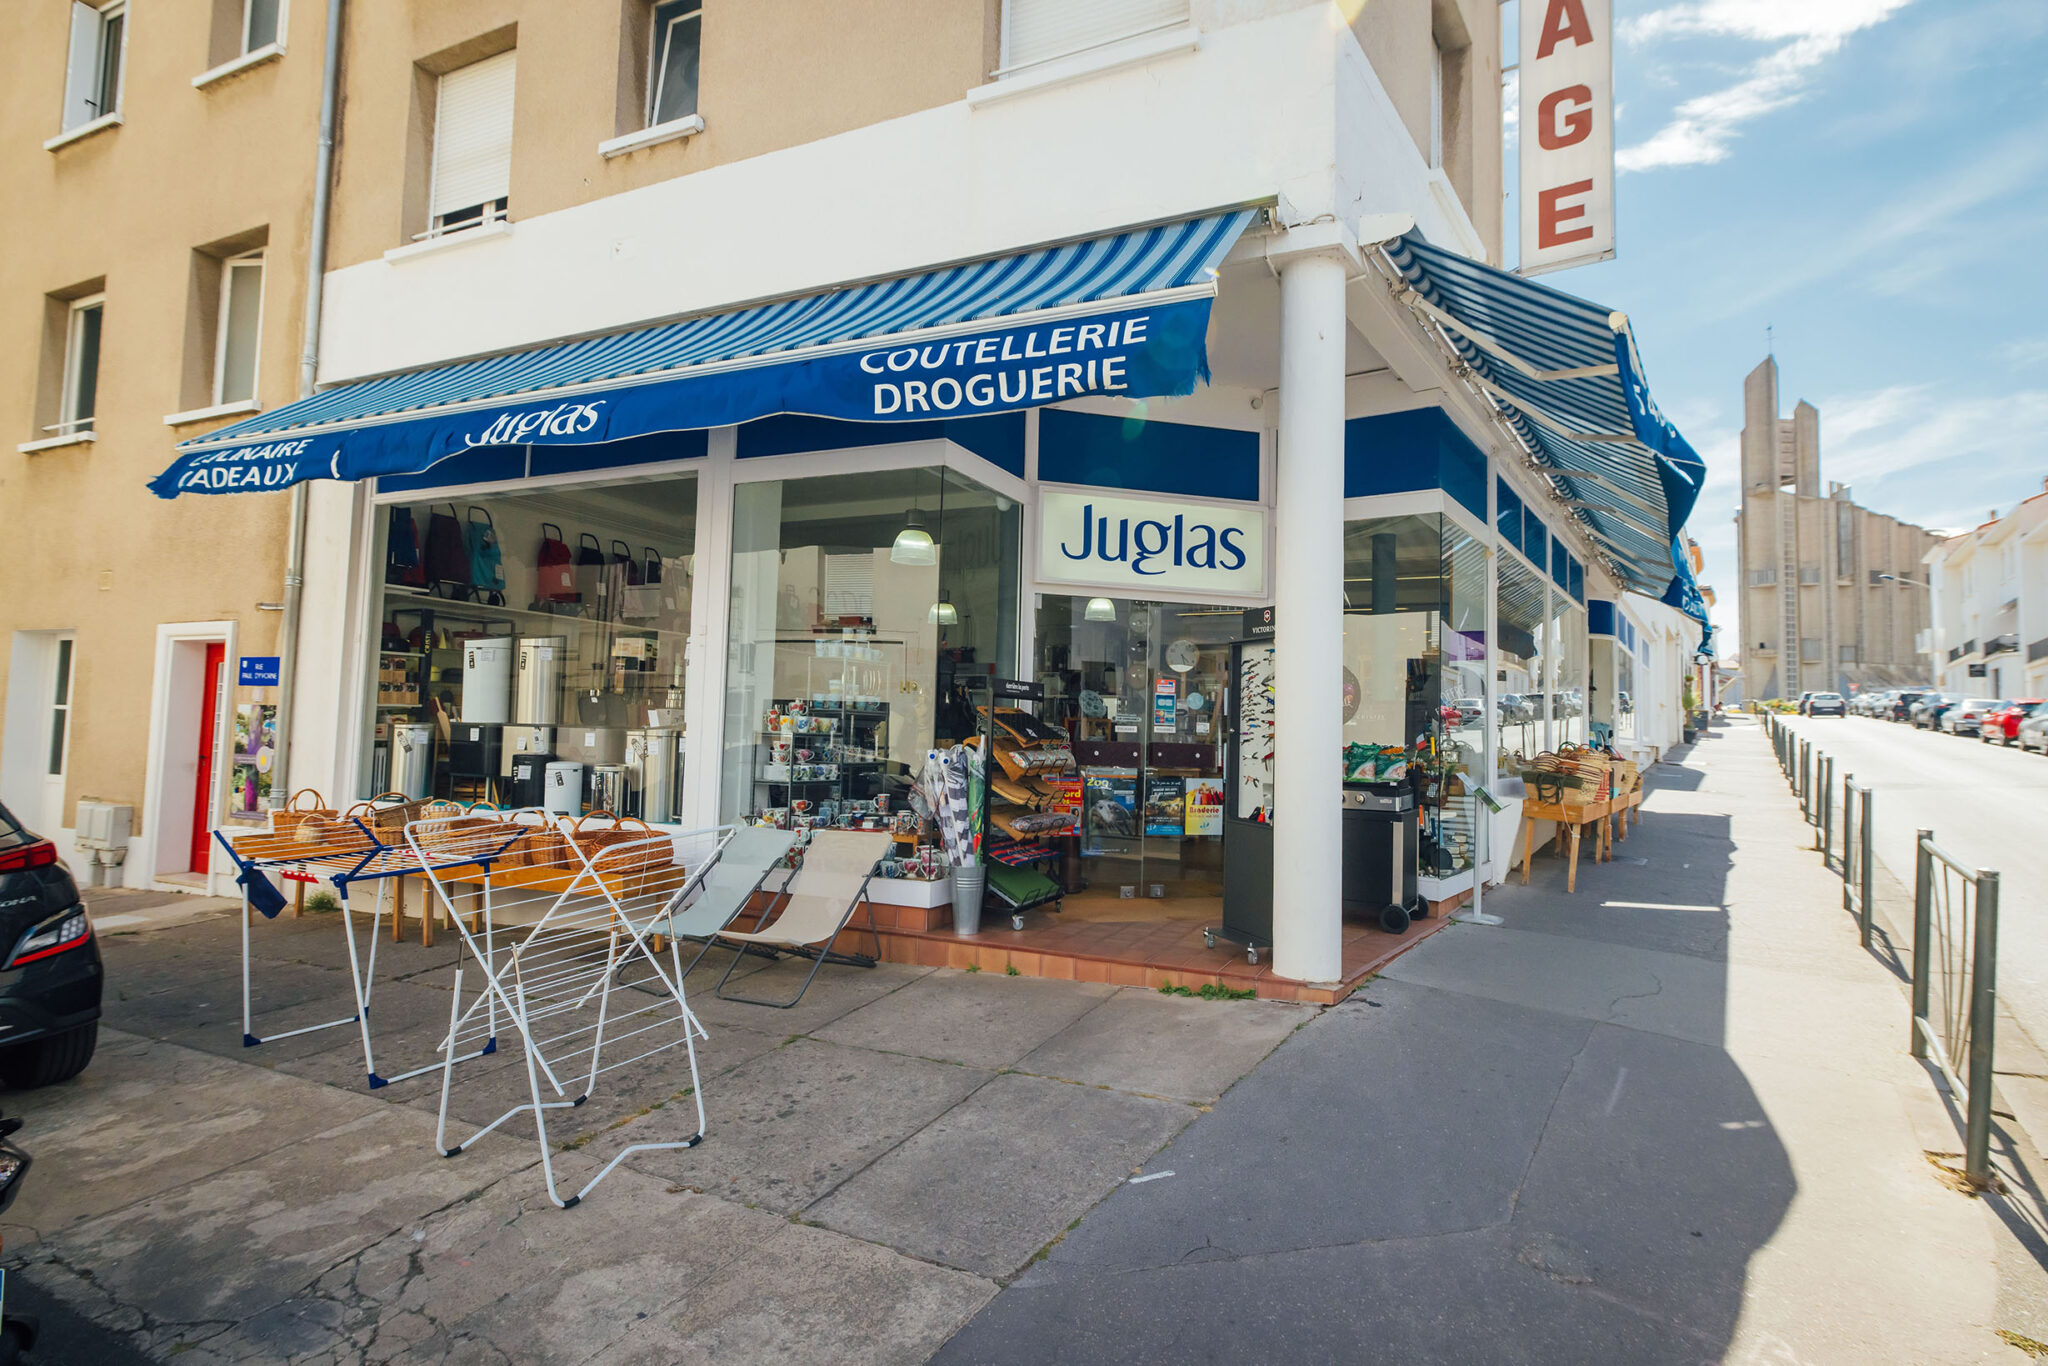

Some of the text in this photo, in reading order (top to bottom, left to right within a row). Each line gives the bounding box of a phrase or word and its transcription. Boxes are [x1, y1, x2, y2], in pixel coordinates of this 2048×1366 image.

[859, 315, 1151, 375] COUTELLERIE
[872, 355, 1129, 415] DROGUERIE
[464, 399, 608, 446] Juglas
[1060, 503, 1247, 575] Juglas
